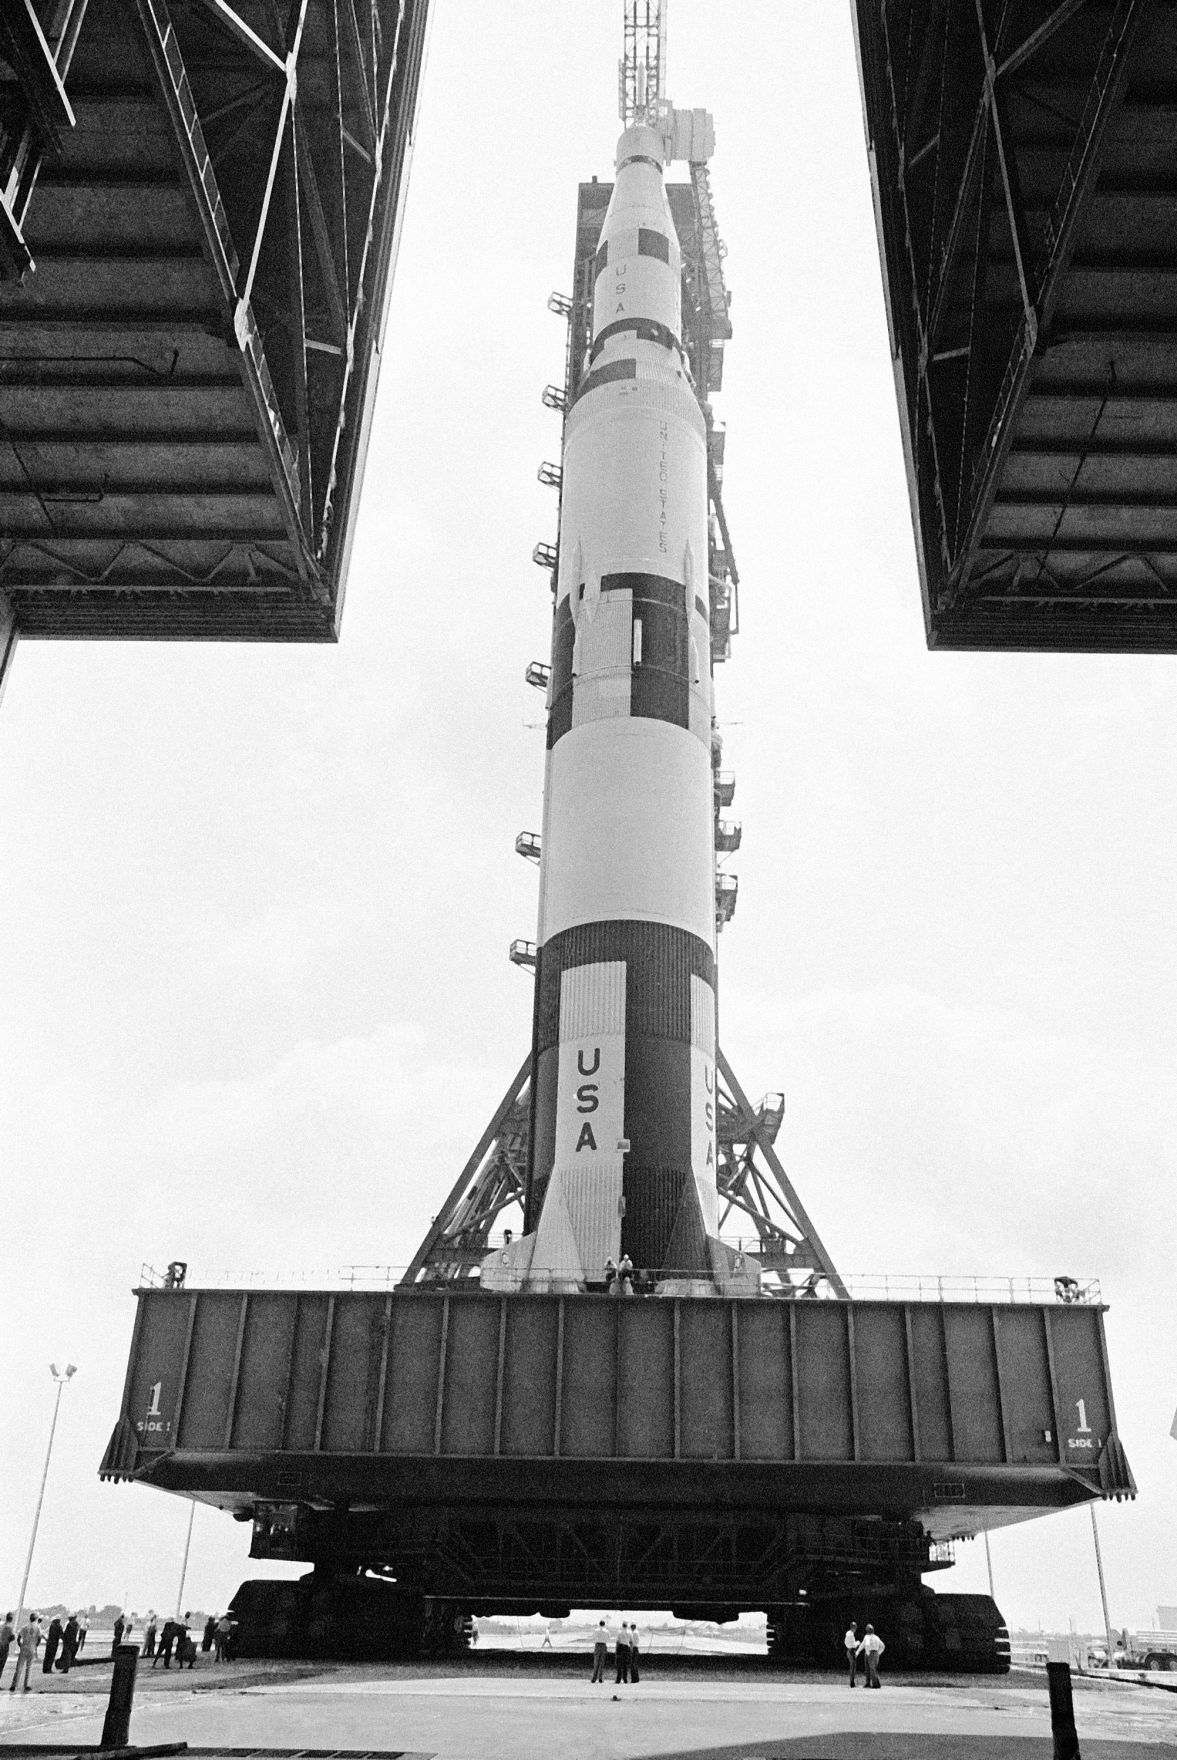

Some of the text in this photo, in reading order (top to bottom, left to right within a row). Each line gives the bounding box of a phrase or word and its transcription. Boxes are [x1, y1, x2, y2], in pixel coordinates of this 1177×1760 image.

[615, 263, 627, 314] USA
[659, 420, 668, 553] UNITED STATES
[575, 1048, 600, 1152] USA
[704, 1065, 714, 1167] USA
[146, 1381, 162, 1416] 1
[1075, 1398, 1092, 1432] 1
[136, 1421, 163, 1432] SIDE
[1067, 1438, 1093, 1448] SIDE
